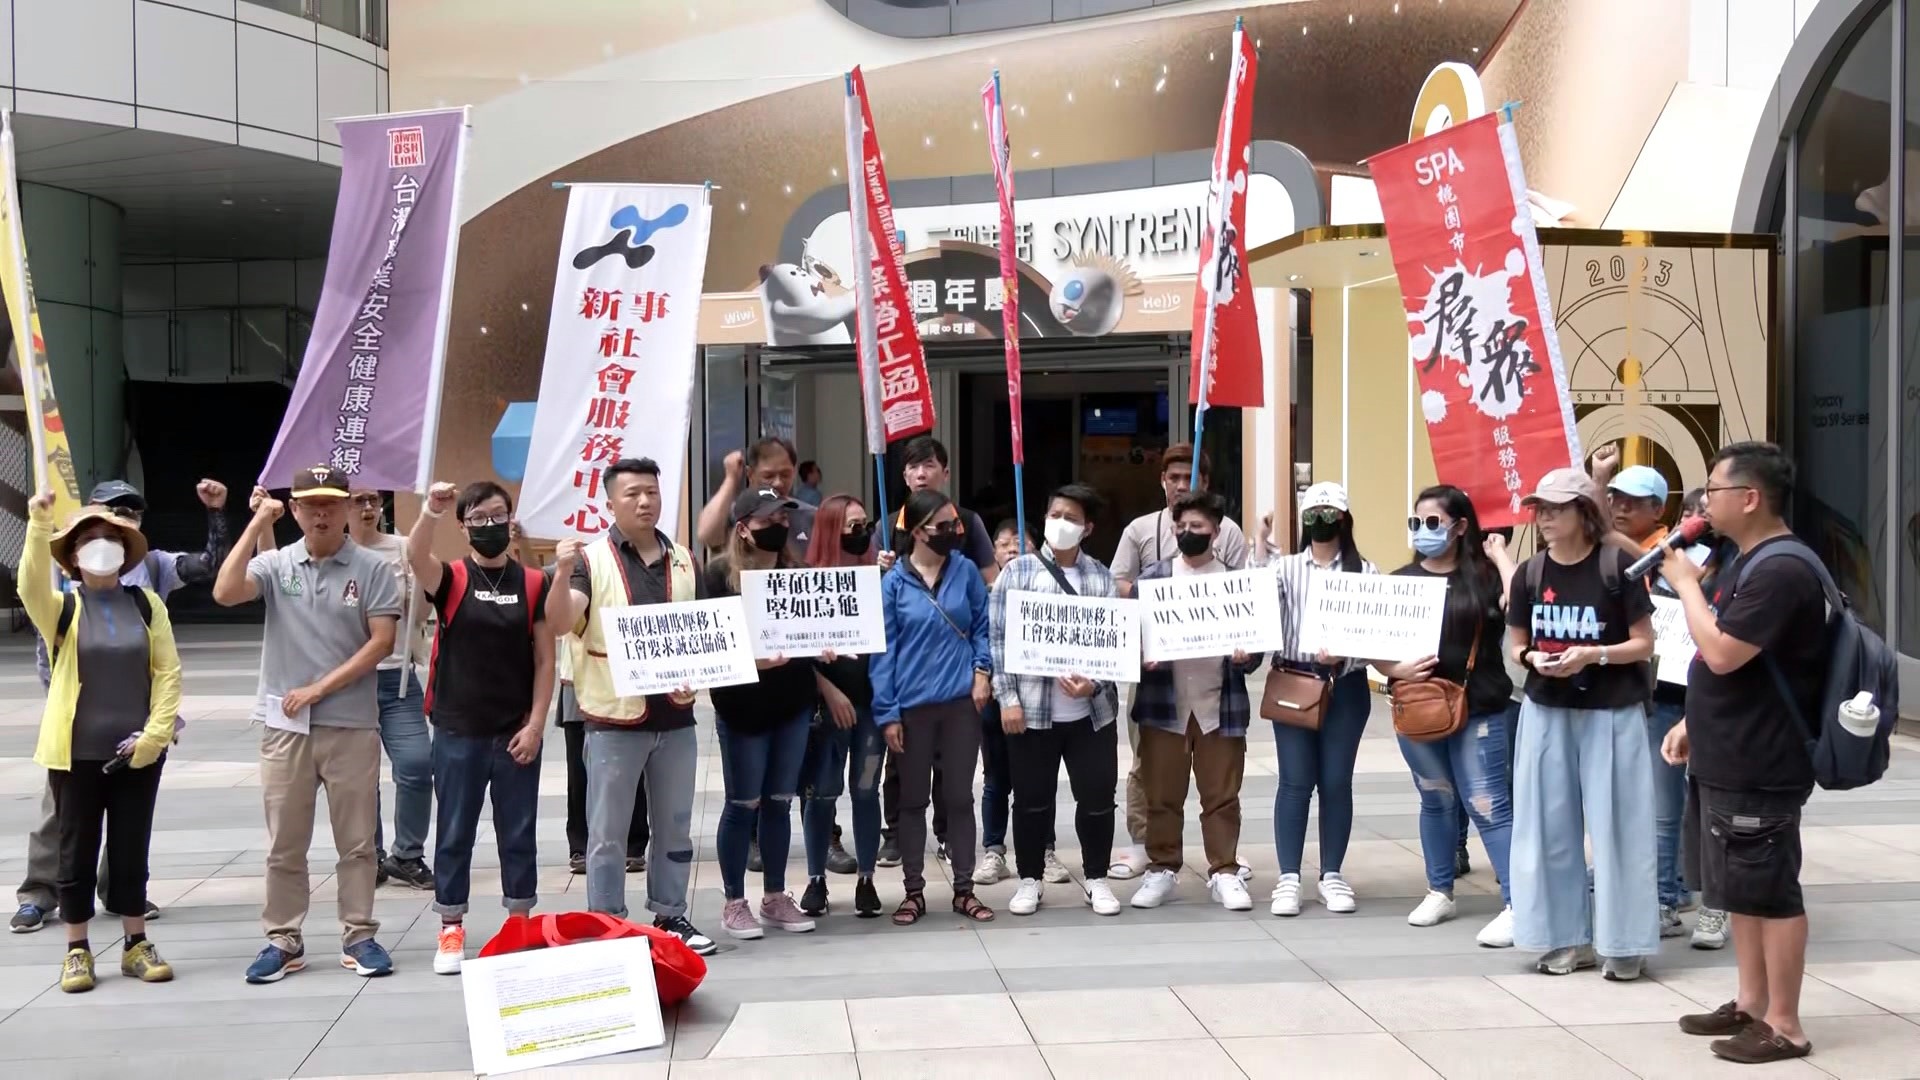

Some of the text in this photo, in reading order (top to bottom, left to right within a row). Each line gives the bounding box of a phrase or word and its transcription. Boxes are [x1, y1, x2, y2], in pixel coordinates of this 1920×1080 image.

[394, 143, 418, 154] OSH
[394, 154, 418, 166] Link
[1415, 147, 1465, 186] SPA
[1053, 205, 1204, 262] SYNTREN
[1436, 184, 1466, 255] 桃園市
[1143, 293, 1181, 309] Hello
[1577, 392, 1681, 402] SYNTEND
[563, 326, 643, 535] 社會服務中心
[765, 570, 857, 597] 華碩集團
[1532, 604, 1600, 640] FIWA
